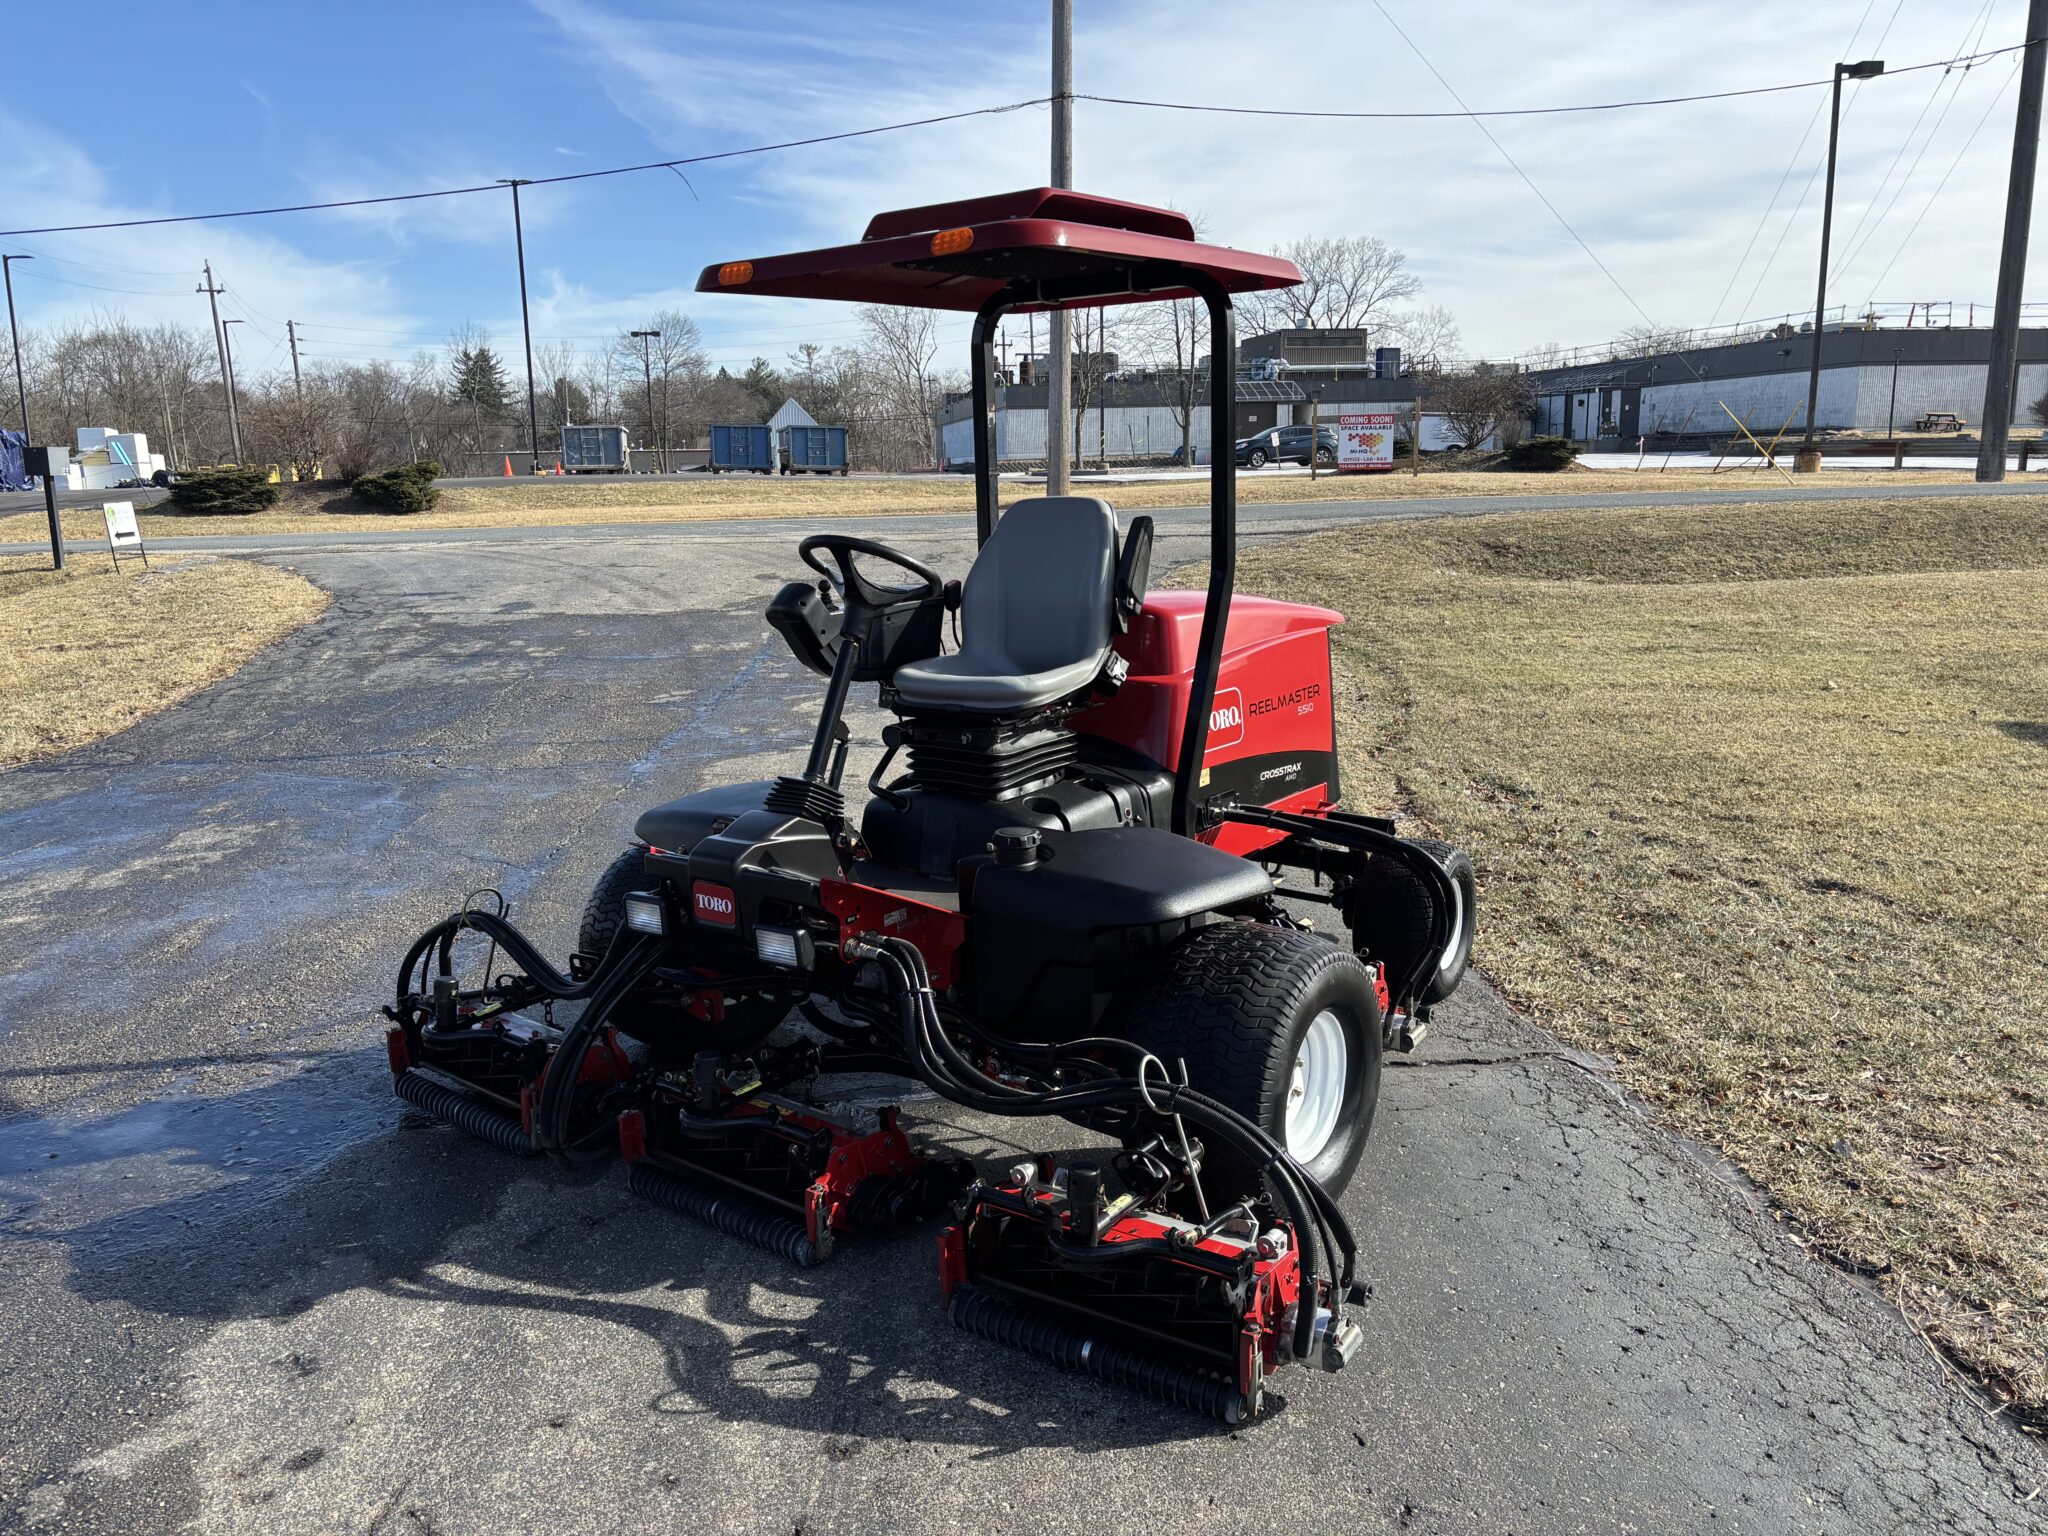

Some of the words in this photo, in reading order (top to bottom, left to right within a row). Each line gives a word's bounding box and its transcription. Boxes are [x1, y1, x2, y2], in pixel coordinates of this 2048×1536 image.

[1249, 684, 1320, 717] REELMASTER
[1297, 702, 1314, 716] 5510
[1260, 761, 1302, 781] CROSSTRAX
[695, 893, 732, 914] TORO
